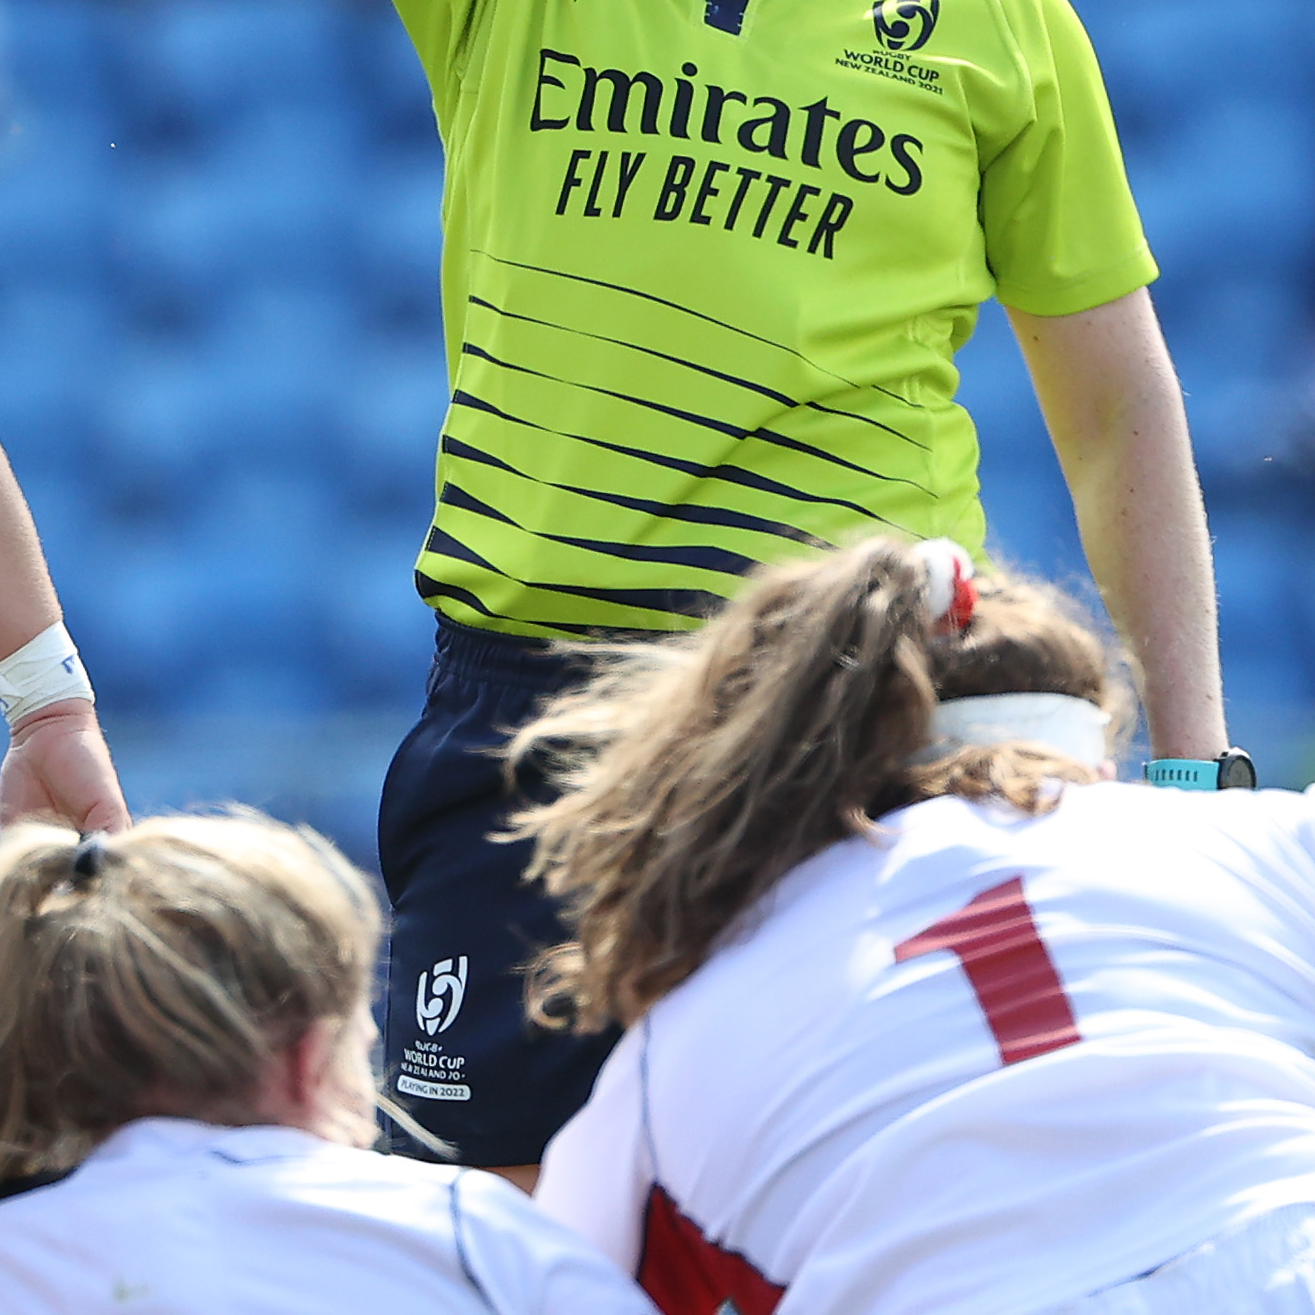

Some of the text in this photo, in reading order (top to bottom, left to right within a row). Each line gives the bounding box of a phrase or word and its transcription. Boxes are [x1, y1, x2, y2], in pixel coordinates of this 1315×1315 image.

[835, 58, 943, 95] NEW ZEALAND 2021
[844, 48, 939, 82] WORLD CUP
[530, 48, 924, 196] Emirates
[555, 149, 853, 260] FLY BETTER
[893, 875, 1083, 1067] 1
[404, 1048, 465, 1069] WORLD CUP
[401, 1080, 466, 1097] PLAYING IN 2022
